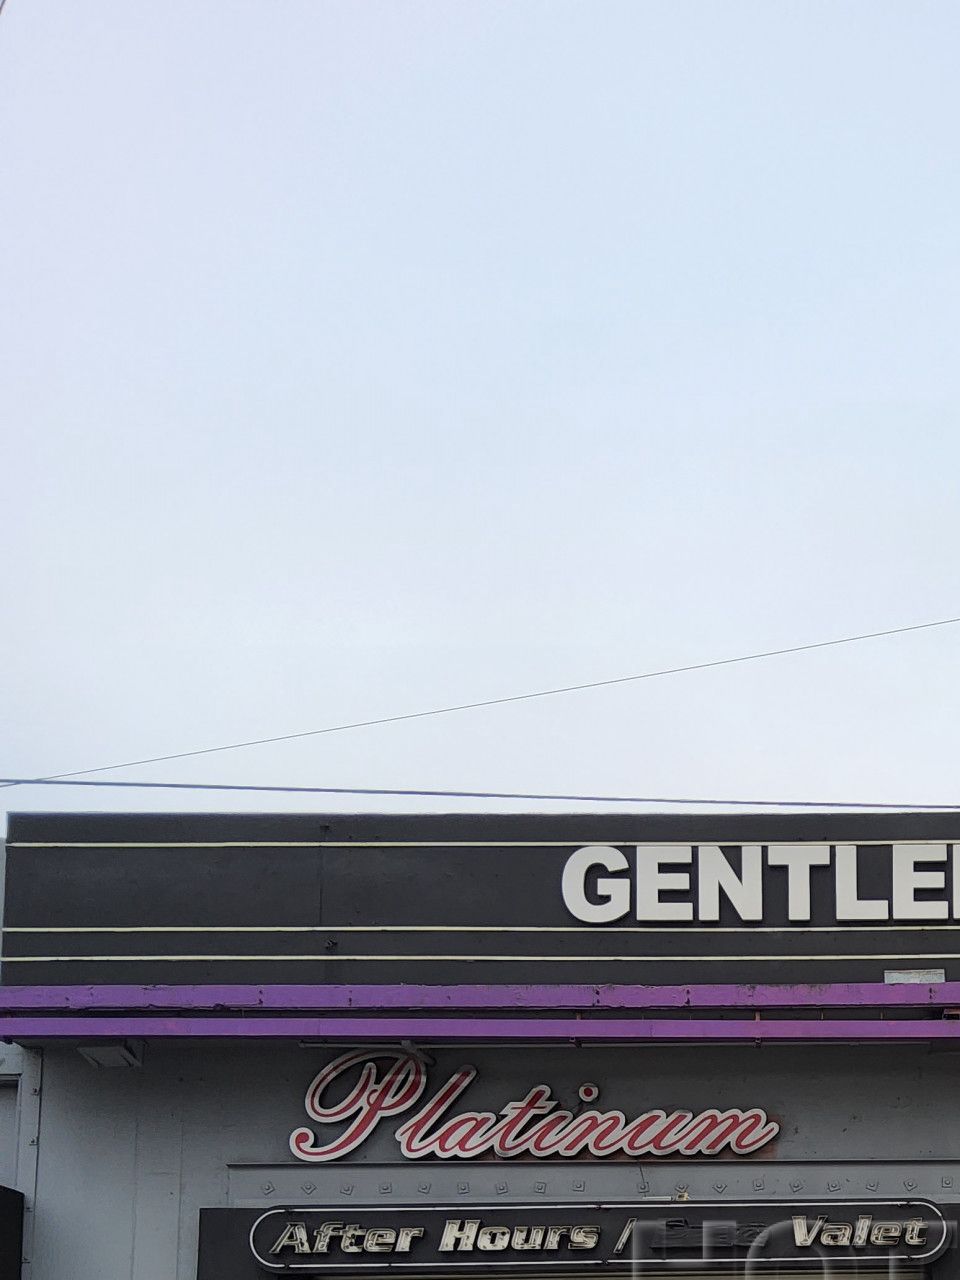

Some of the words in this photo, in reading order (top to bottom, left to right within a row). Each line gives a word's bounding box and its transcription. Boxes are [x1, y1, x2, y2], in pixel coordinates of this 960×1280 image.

[289, 1048, 780, 1163] Platinum
[269, 1219, 424, 1254] After
[438, 1218, 601, 1252] Hours
[791, 1214, 929, 1248] Valet
